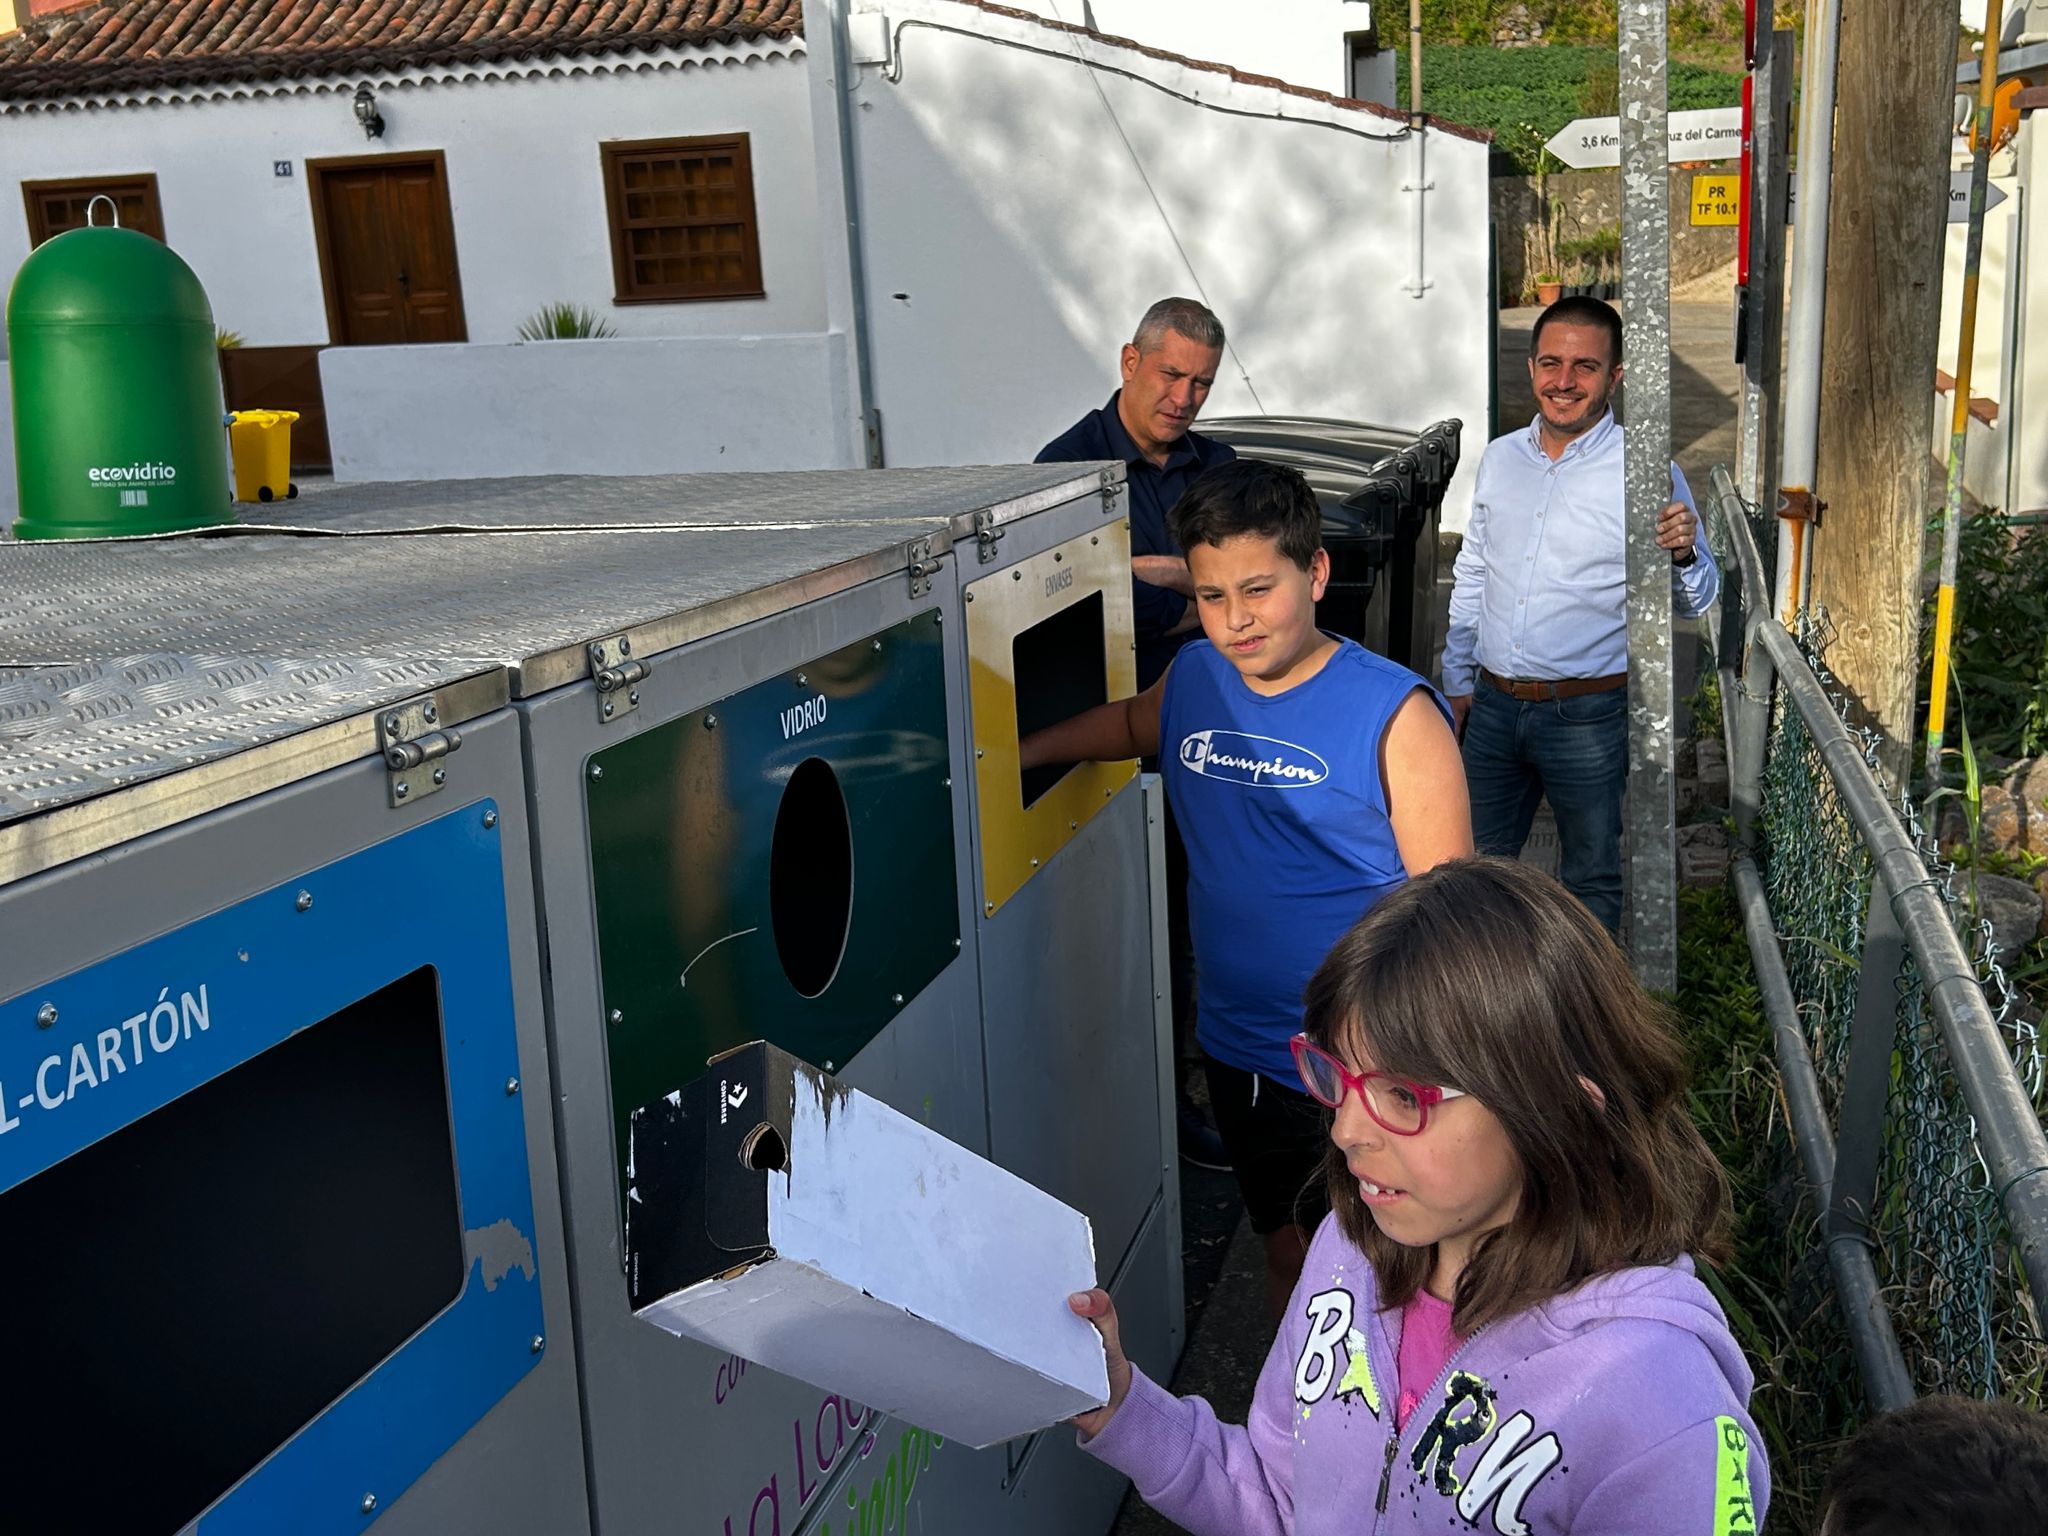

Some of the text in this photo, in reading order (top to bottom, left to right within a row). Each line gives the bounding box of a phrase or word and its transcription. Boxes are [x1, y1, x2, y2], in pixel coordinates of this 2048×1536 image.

[1581, 136, 1598, 149] 3,6
[1600, 136, 1619, 147] Km
[1668, 132, 1683, 142] uz
[1685, 128, 1702, 140] del
[1708, 186, 1726, 198] PR
[1697, 203, 1738, 217] TF 10.1
[88, 461, 176, 481] ecovidrio
[1045, 566, 1073, 598] ENVASES
[780, 694, 827, 740] VIDRIO
[1182, 737, 1321, 783] Champion
[720, 1079, 728, 1125] CONVERSE
